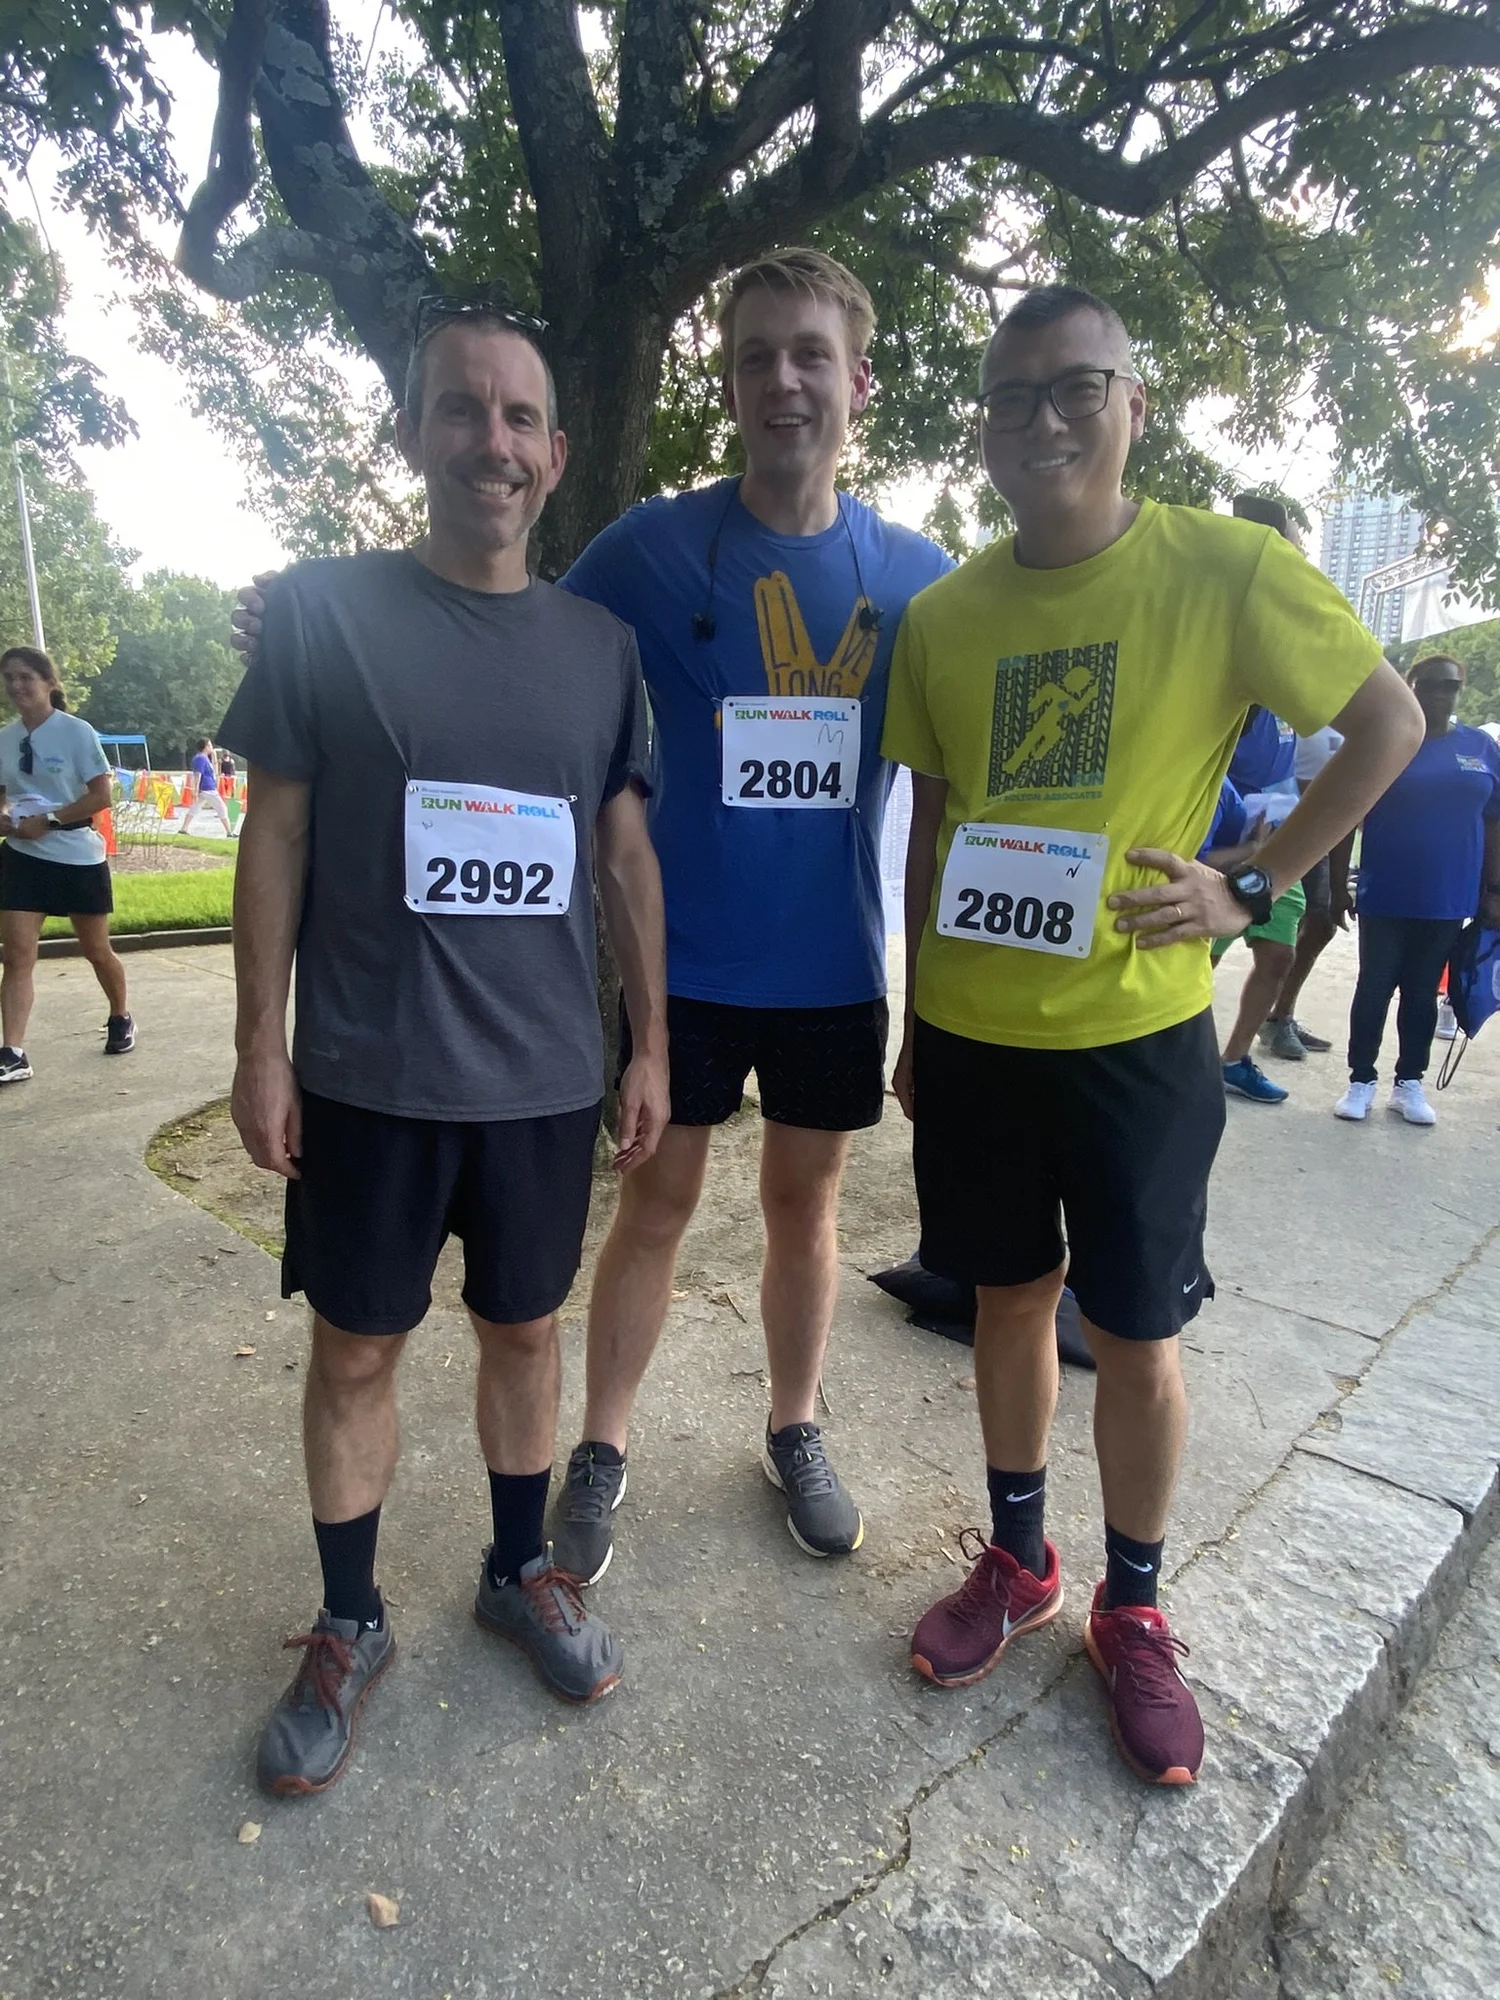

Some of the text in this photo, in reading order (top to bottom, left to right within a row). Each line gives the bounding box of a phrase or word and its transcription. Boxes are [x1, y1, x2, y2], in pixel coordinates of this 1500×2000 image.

[735, 710, 849, 721] RUN WALK ROLL
[739, 760, 842, 799] 2804
[421, 797, 560, 819] RUN WALK ROLL
[964, 835, 1091, 860] RUN WALK ROLL
[426, 857, 554, 905] 2992
[954, 888, 1075, 945] 2808
